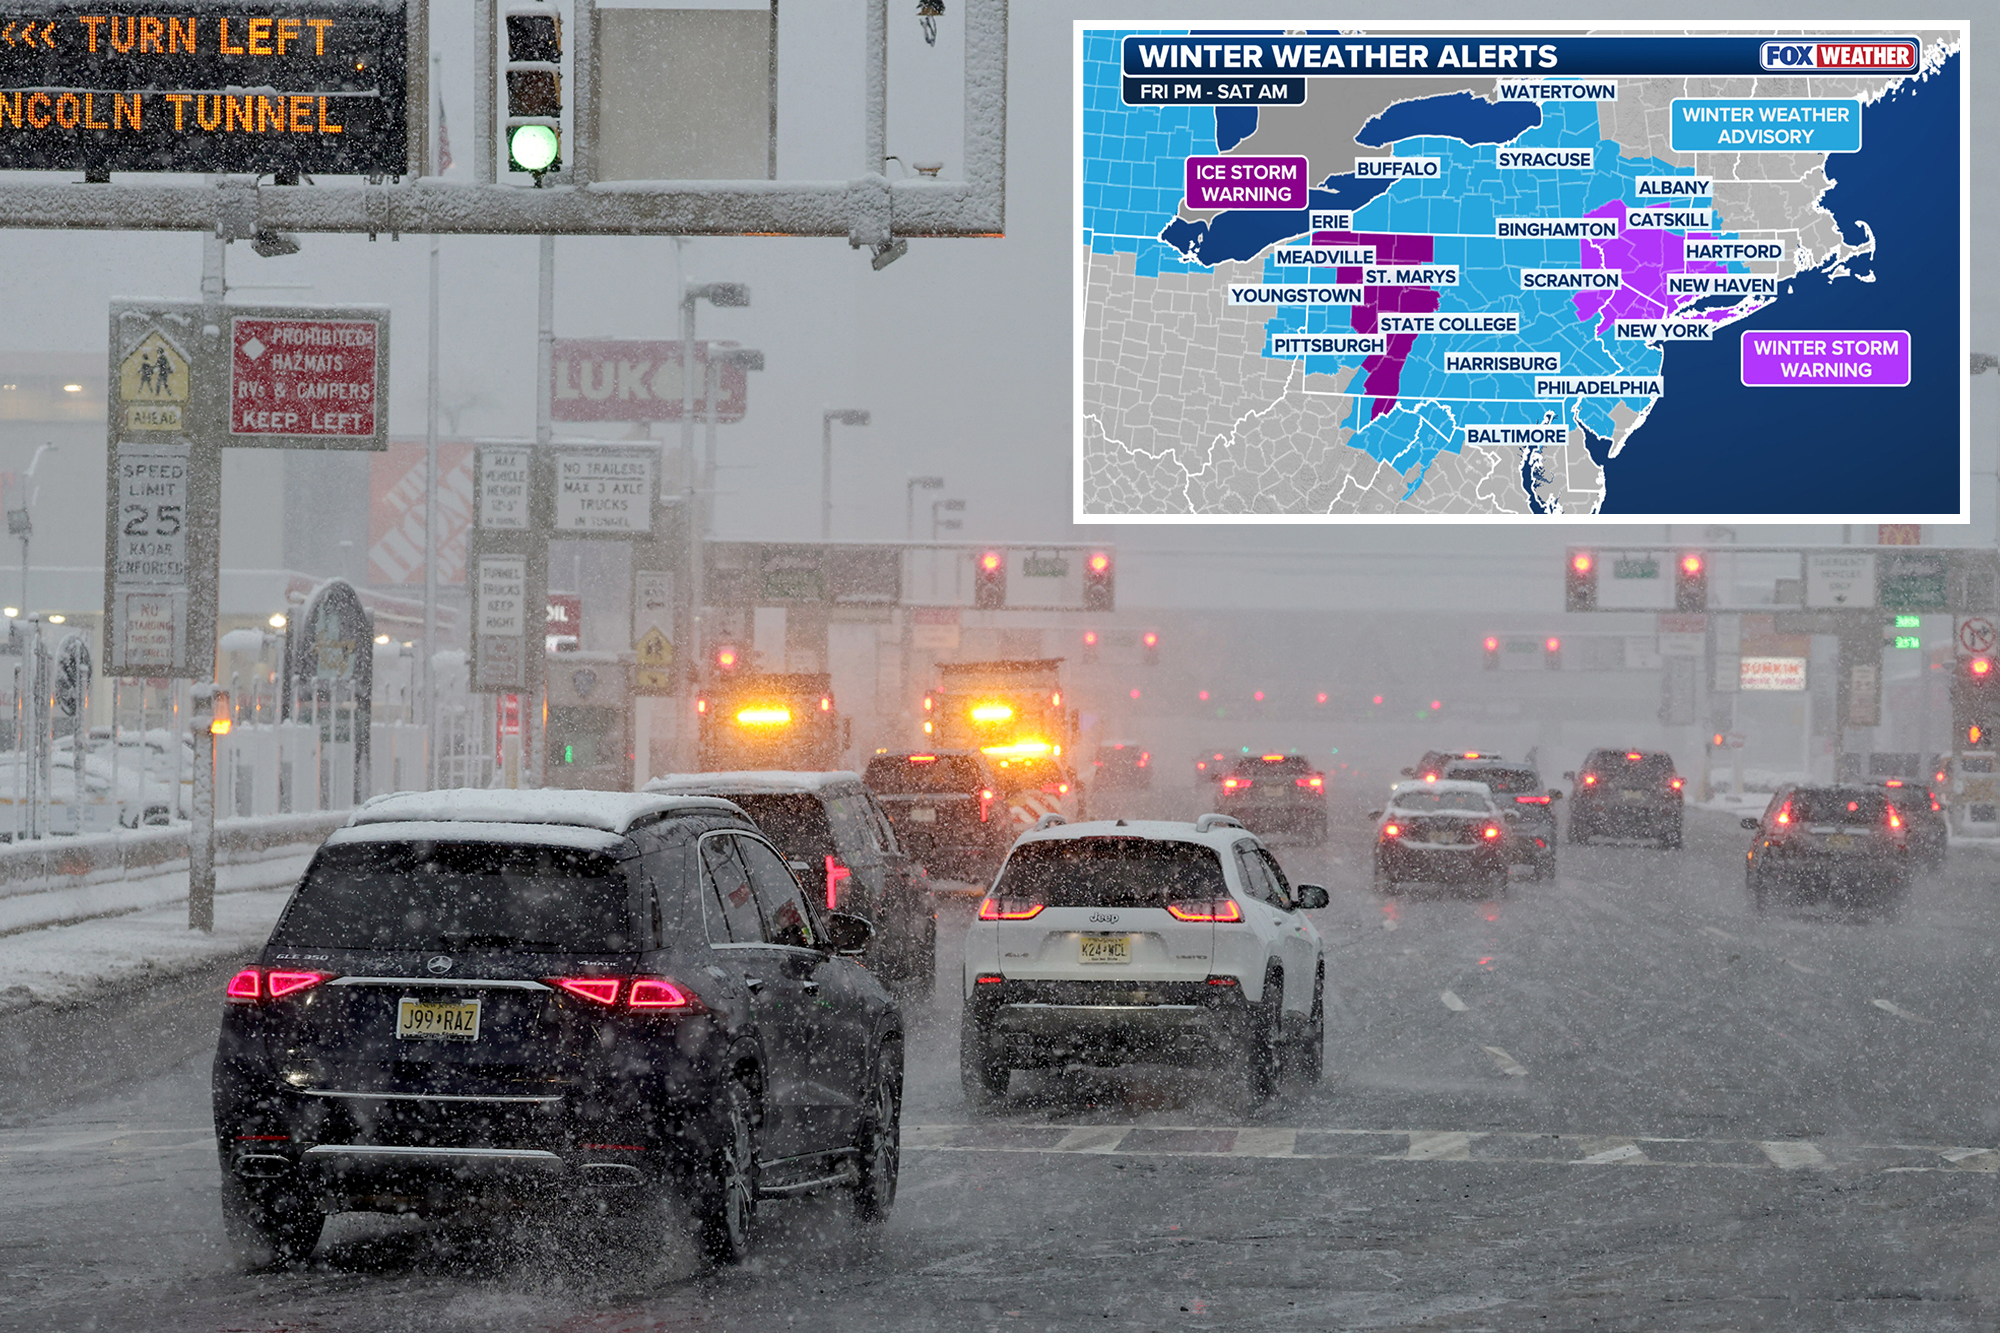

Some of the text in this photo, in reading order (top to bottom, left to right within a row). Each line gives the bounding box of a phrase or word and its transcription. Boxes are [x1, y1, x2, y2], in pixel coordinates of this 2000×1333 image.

[80, 16, 334, 55] TURN LEFT
[166, 94, 342, 132] TUNNEL
[271, 352, 343, 372] HAZMATS
[238, 381, 370, 400] RVs & CAMPERS
[134, 411, 177, 425] AHEAD
[242, 411, 363, 430] KEEP LEFT
[123, 465, 183, 479] SPEED
[563, 463, 646, 476] NO TRAILERS
[129, 483, 176, 496] LIMIT
[564, 482, 590, 494] MAX
[612, 483, 644, 496] AXLE
[580, 499, 629, 511] TRUCKS
[124, 504, 181, 536] 25
[118, 560, 184, 576] ENFORCED
[141, 603, 159, 617] NO
[1089, 911, 1119, 924] Jeep
